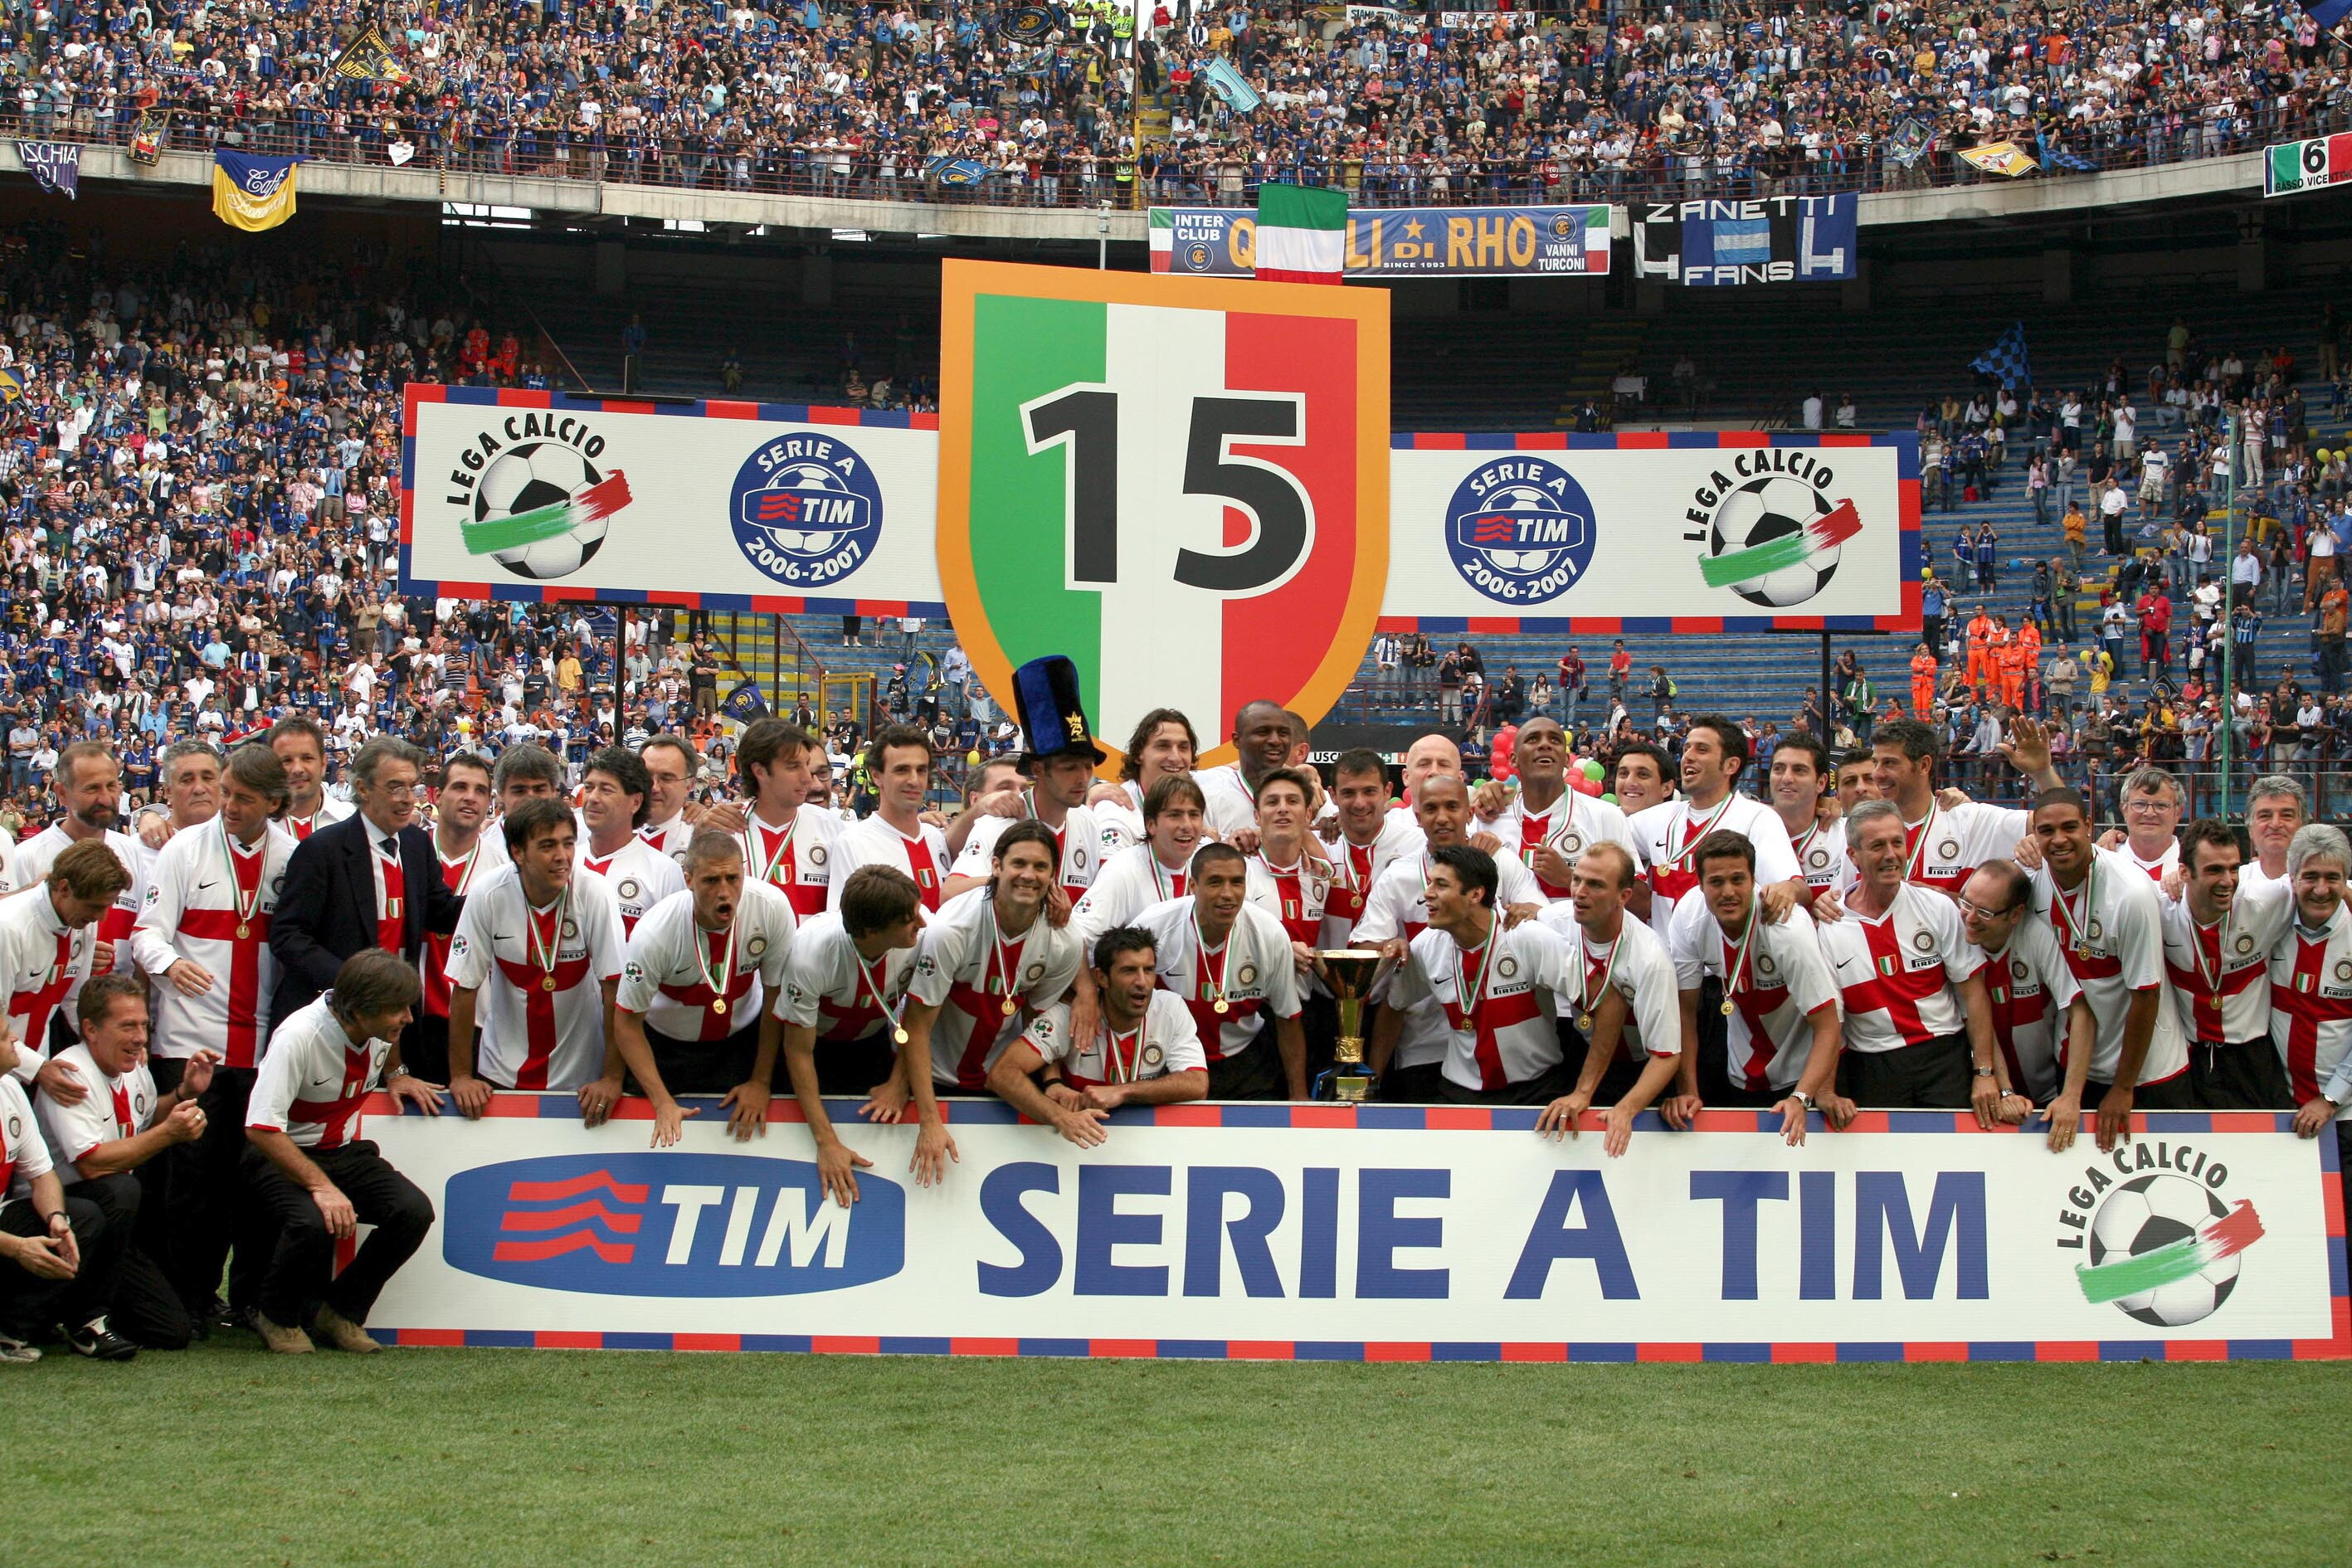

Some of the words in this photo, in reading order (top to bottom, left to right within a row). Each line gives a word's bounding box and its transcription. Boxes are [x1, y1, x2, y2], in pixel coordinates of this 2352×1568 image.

[18, 142, 79, 166] ISCHIA
[2303, 139, 2326, 173] 6
[2275, 178, 2304, 192] BASSO
[1175, 214, 1225, 228] INTER
[1646, 195, 1836, 223] ZANETTI
[1176, 228, 1221, 241] CLUB
[1394, 242, 1434, 259] DI
[1447, 216, 1536, 268] RHO
[1545, 244, 1578, 257] VANNI
[1538, 257, 1585, 271] TURCONI
[1684, 261, 1794, 286] FANS
[447, 431, 502, 505] LEGA
[504, 412, 606, 459] CALCIO
[756, 439, 833, 475] SERIE
[834, 455, 856, 477] A
[1029, 391, 1307, 591] 15
[1469, 462, 1542, 497] SERIE
[1546, 477, 1569, 497] A
[1683, 470, 1734, 541] LEGA
[1734, 449, 1833, 489] CALCIO
[802, 499, 856, 524] TIM
[1517, 519, 1569, 543] TIM
[745, 538, 864, 582] 2006-2007
[1461, 556, 1578, 599] 2006-2007
[1493, 981, 1530, 996] PIRELLI
[2057, 1166, 2114, 1249] LEGA
[2112, 1142, 2228, 1189] CALCIO
[661, 1184, 855, 1269] TIM
[976, 1161, 1452, 1299] SERIE
[1502, 1169, 1642, 1300] A
[1689, 1170, 1990, 1300] TIM
